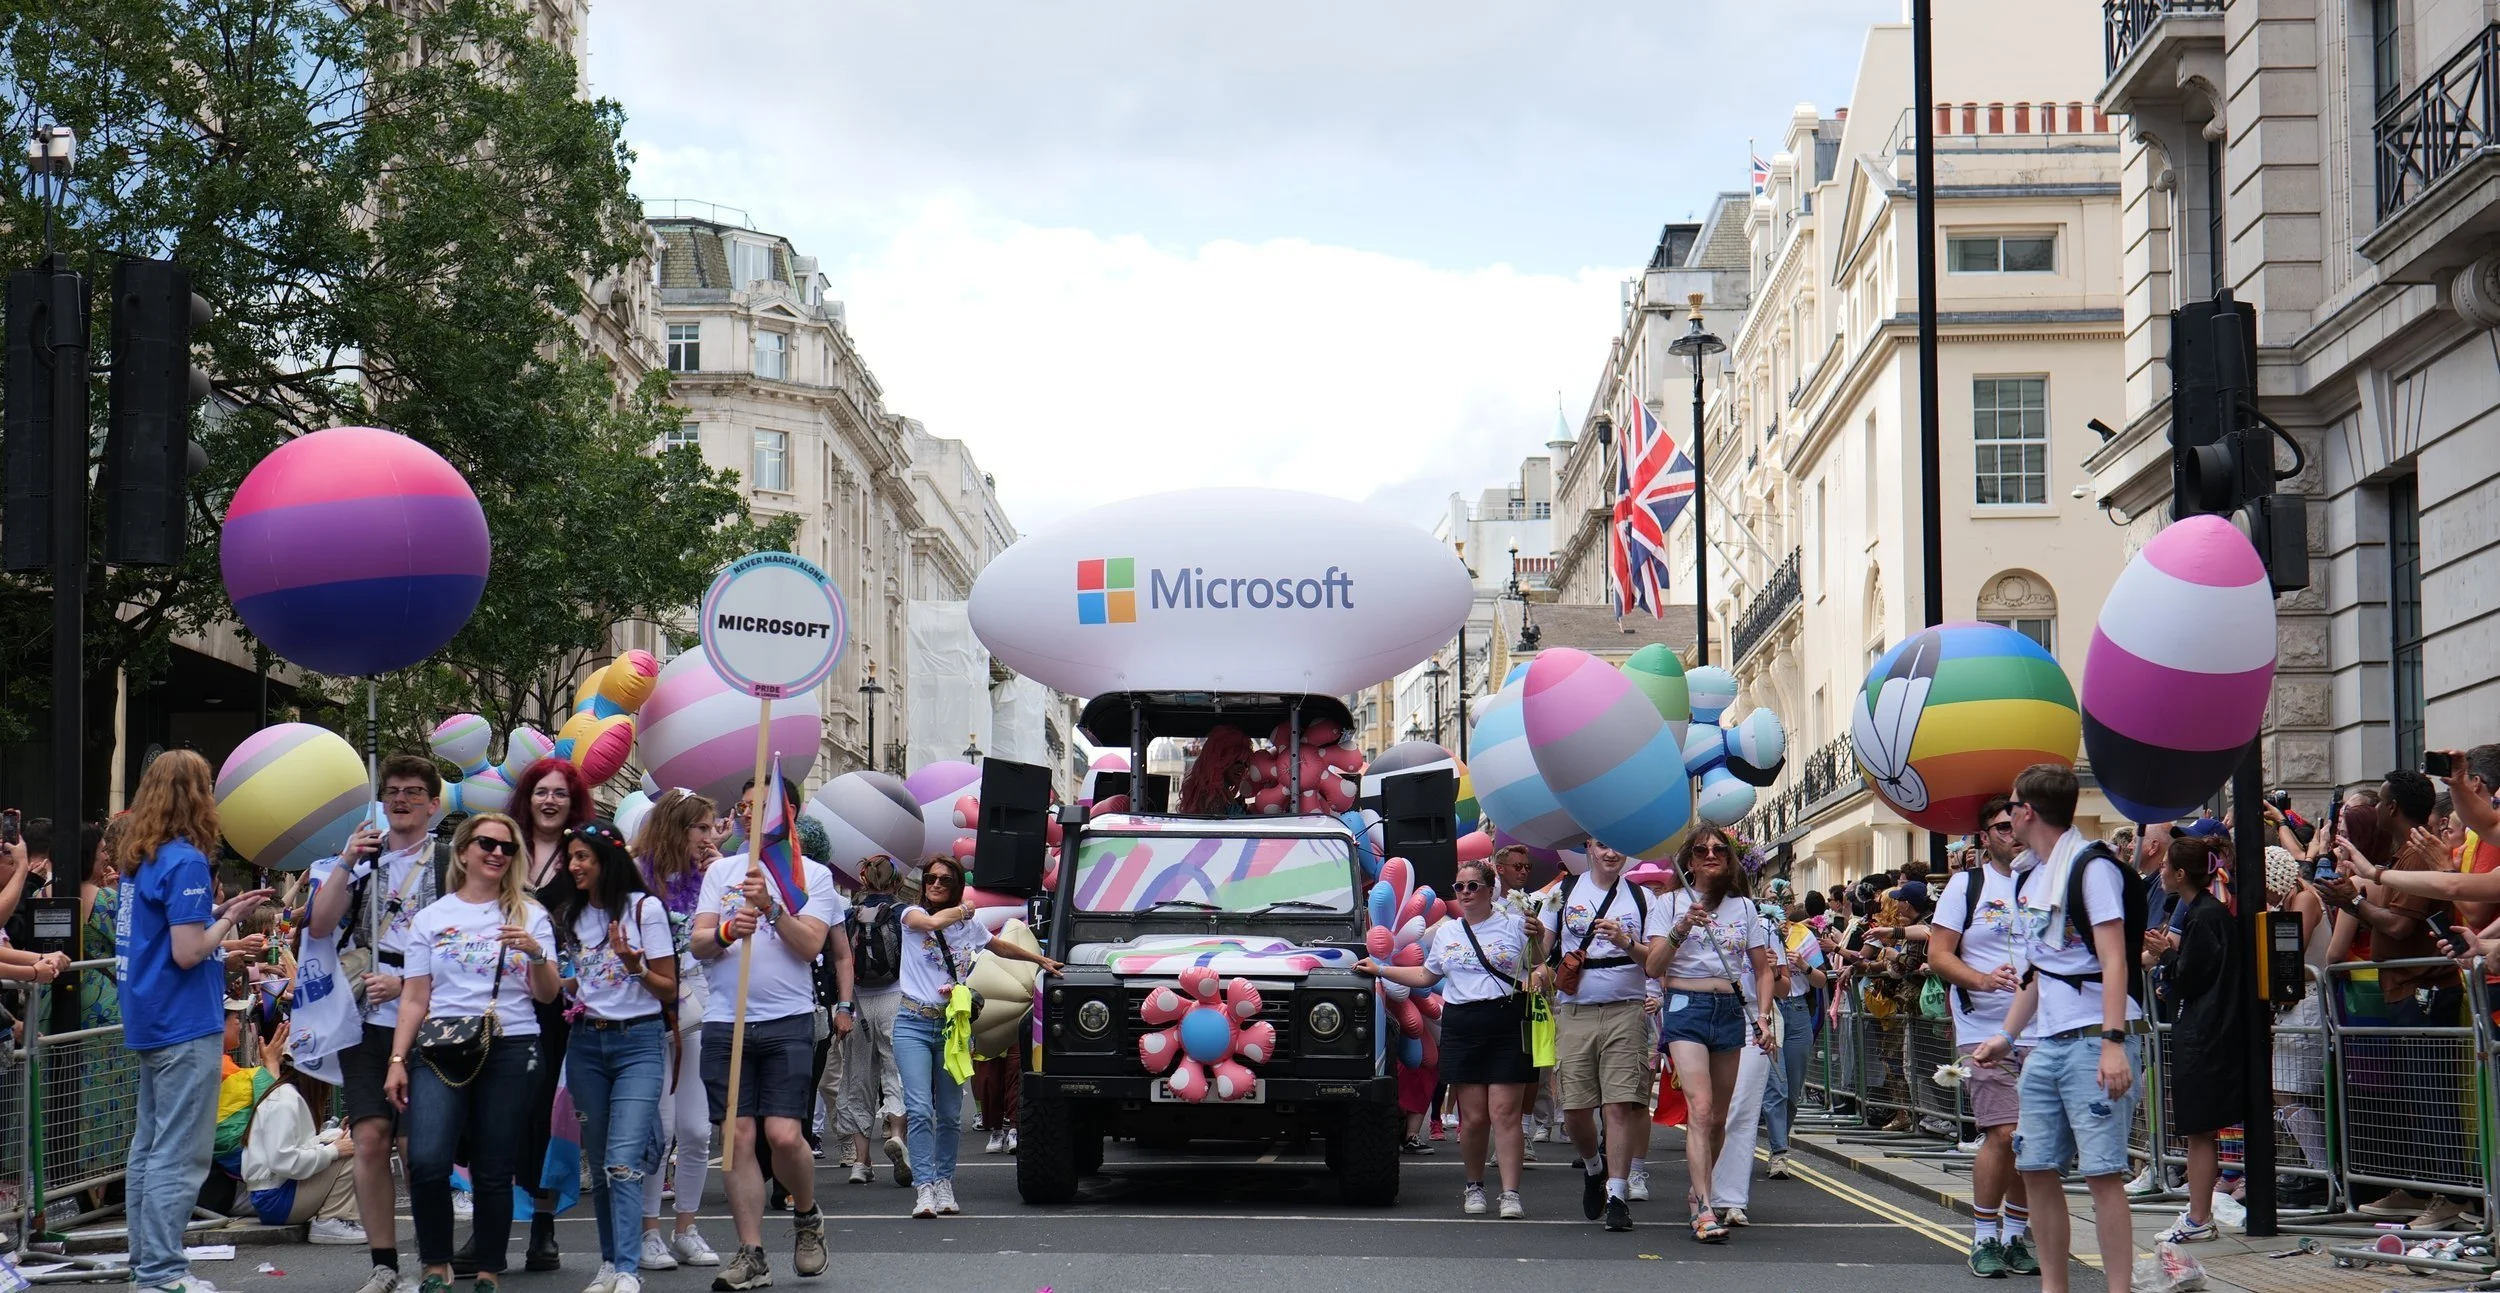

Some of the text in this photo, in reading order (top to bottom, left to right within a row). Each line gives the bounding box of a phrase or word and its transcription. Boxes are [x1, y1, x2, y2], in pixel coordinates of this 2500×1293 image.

[733, 555, 826, 583] NEVER MARCH ALONE
[1150, 564, 1355, 610] Microsoft
[718, 614, 831, 639] MICROSOFT
[755, 684, 781, 694] PRIDE
